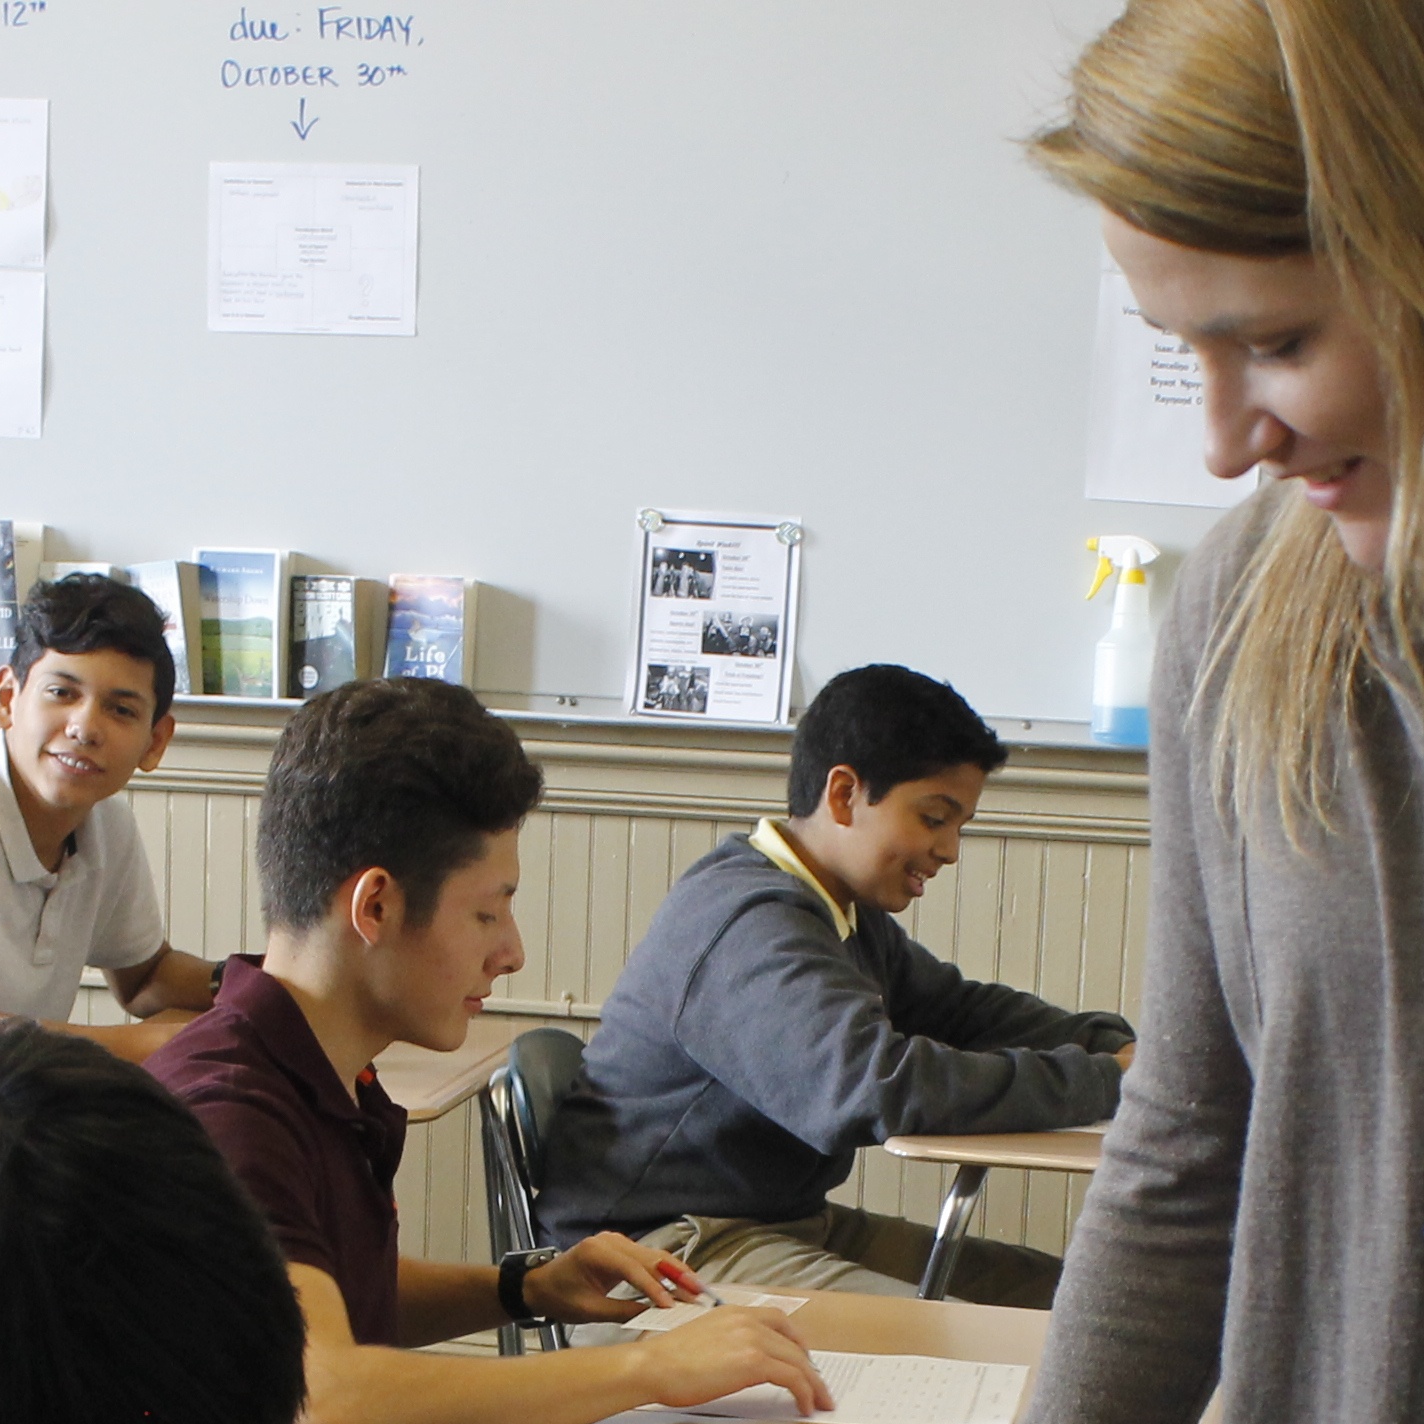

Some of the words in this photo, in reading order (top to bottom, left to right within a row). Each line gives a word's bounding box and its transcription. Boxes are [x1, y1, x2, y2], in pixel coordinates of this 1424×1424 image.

[318, 6, 425, 47] FRIDAY,
[221, 59, 339, 88] OCTOBER
[404, 645, 446, 663] Life
